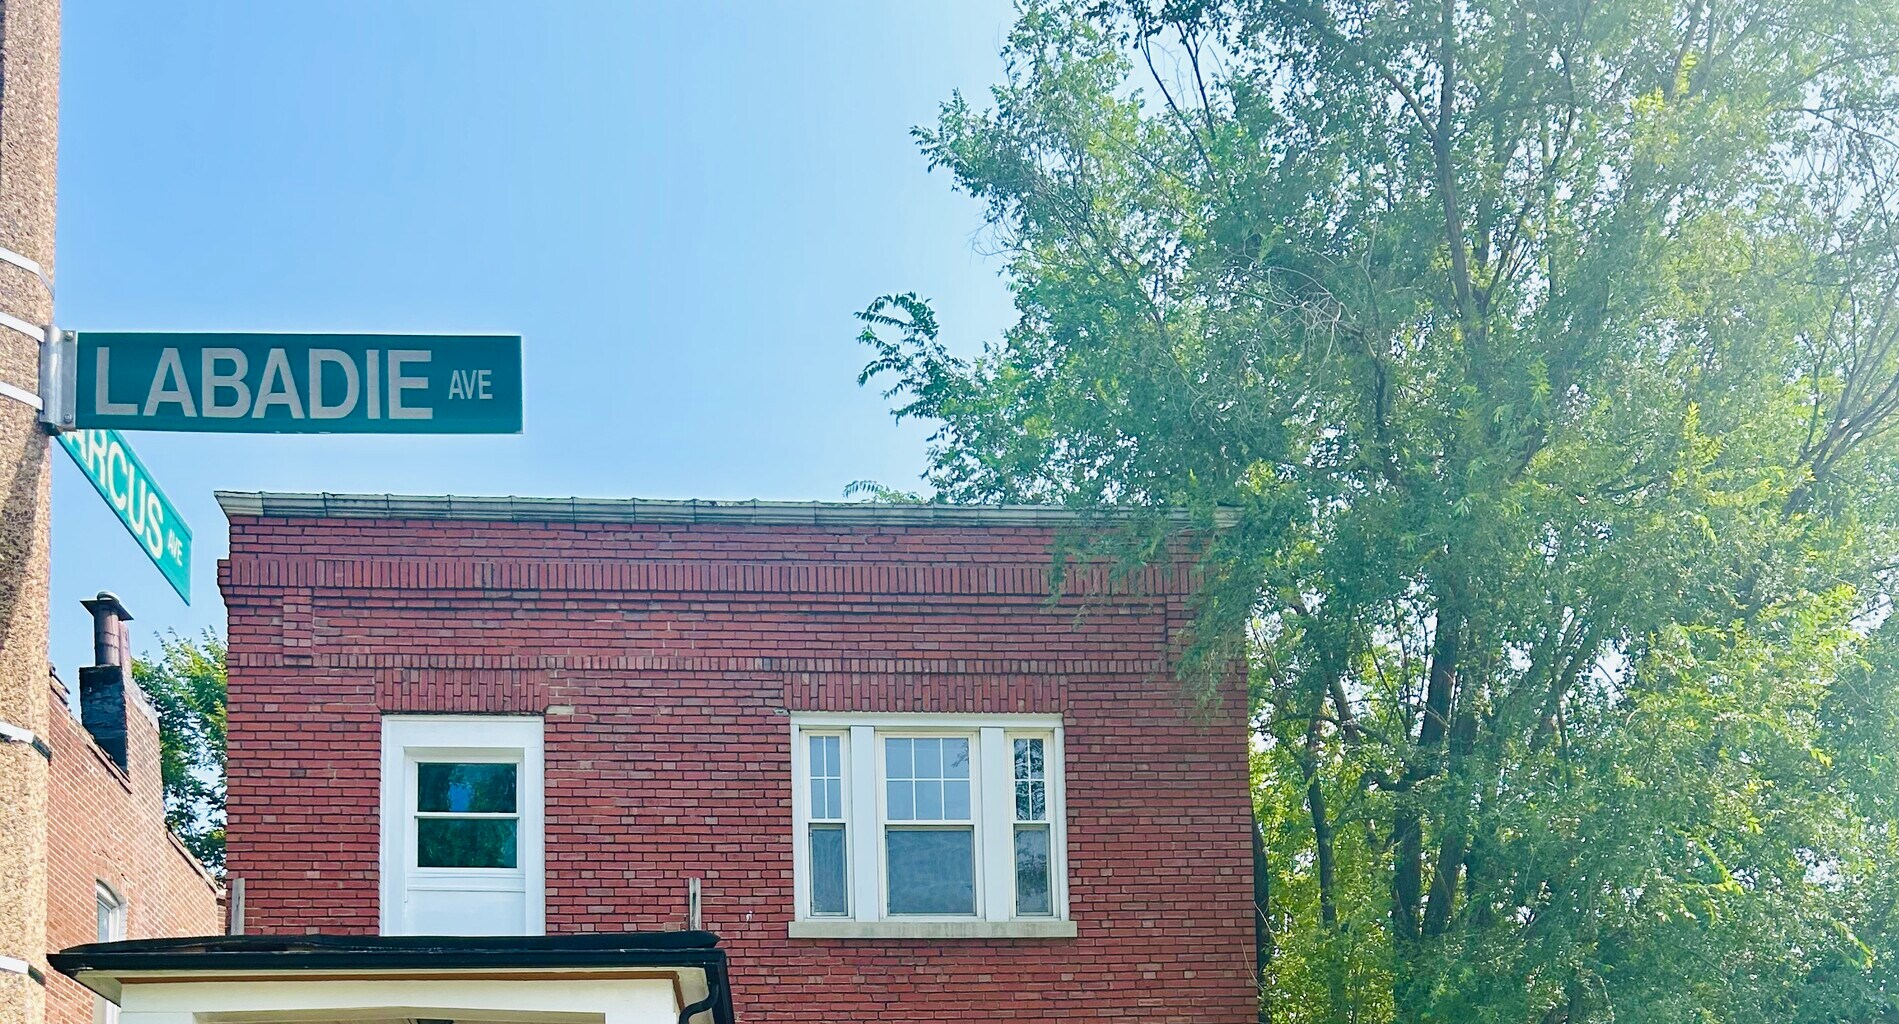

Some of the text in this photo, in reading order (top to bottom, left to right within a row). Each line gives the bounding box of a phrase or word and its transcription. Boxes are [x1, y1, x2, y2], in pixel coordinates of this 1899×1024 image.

[94, 346, 494, 420] LABADIE AVE
[64, 430, 184, 567] RCUS AVE
